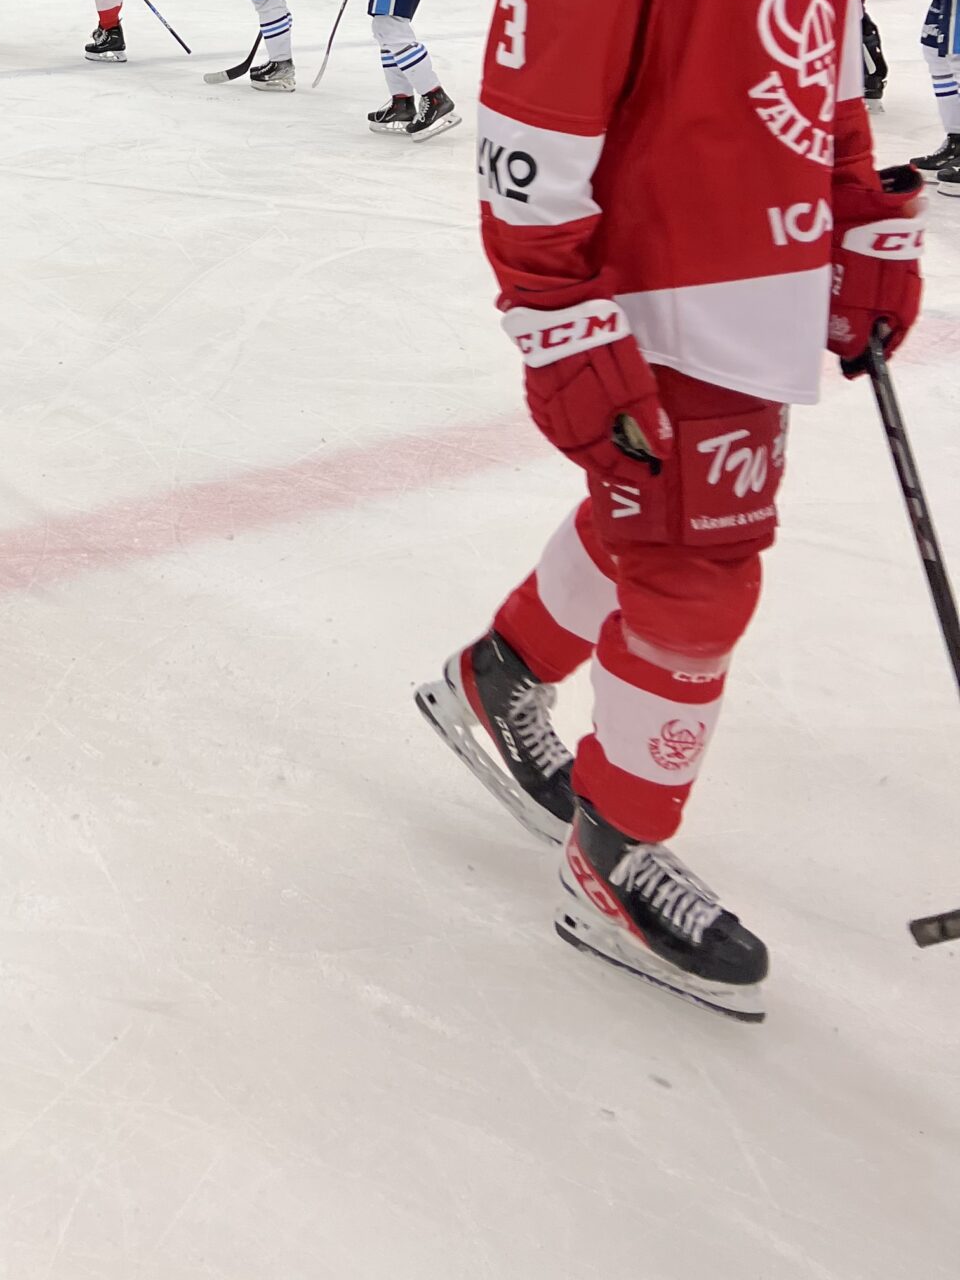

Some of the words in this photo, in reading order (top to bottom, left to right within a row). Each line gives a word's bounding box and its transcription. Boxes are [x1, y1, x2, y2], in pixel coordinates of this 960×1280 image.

[767, 198, 834, 246] ICA
[515, 312, 618, 354] CCM
[696, 429, 768, 498] TW
